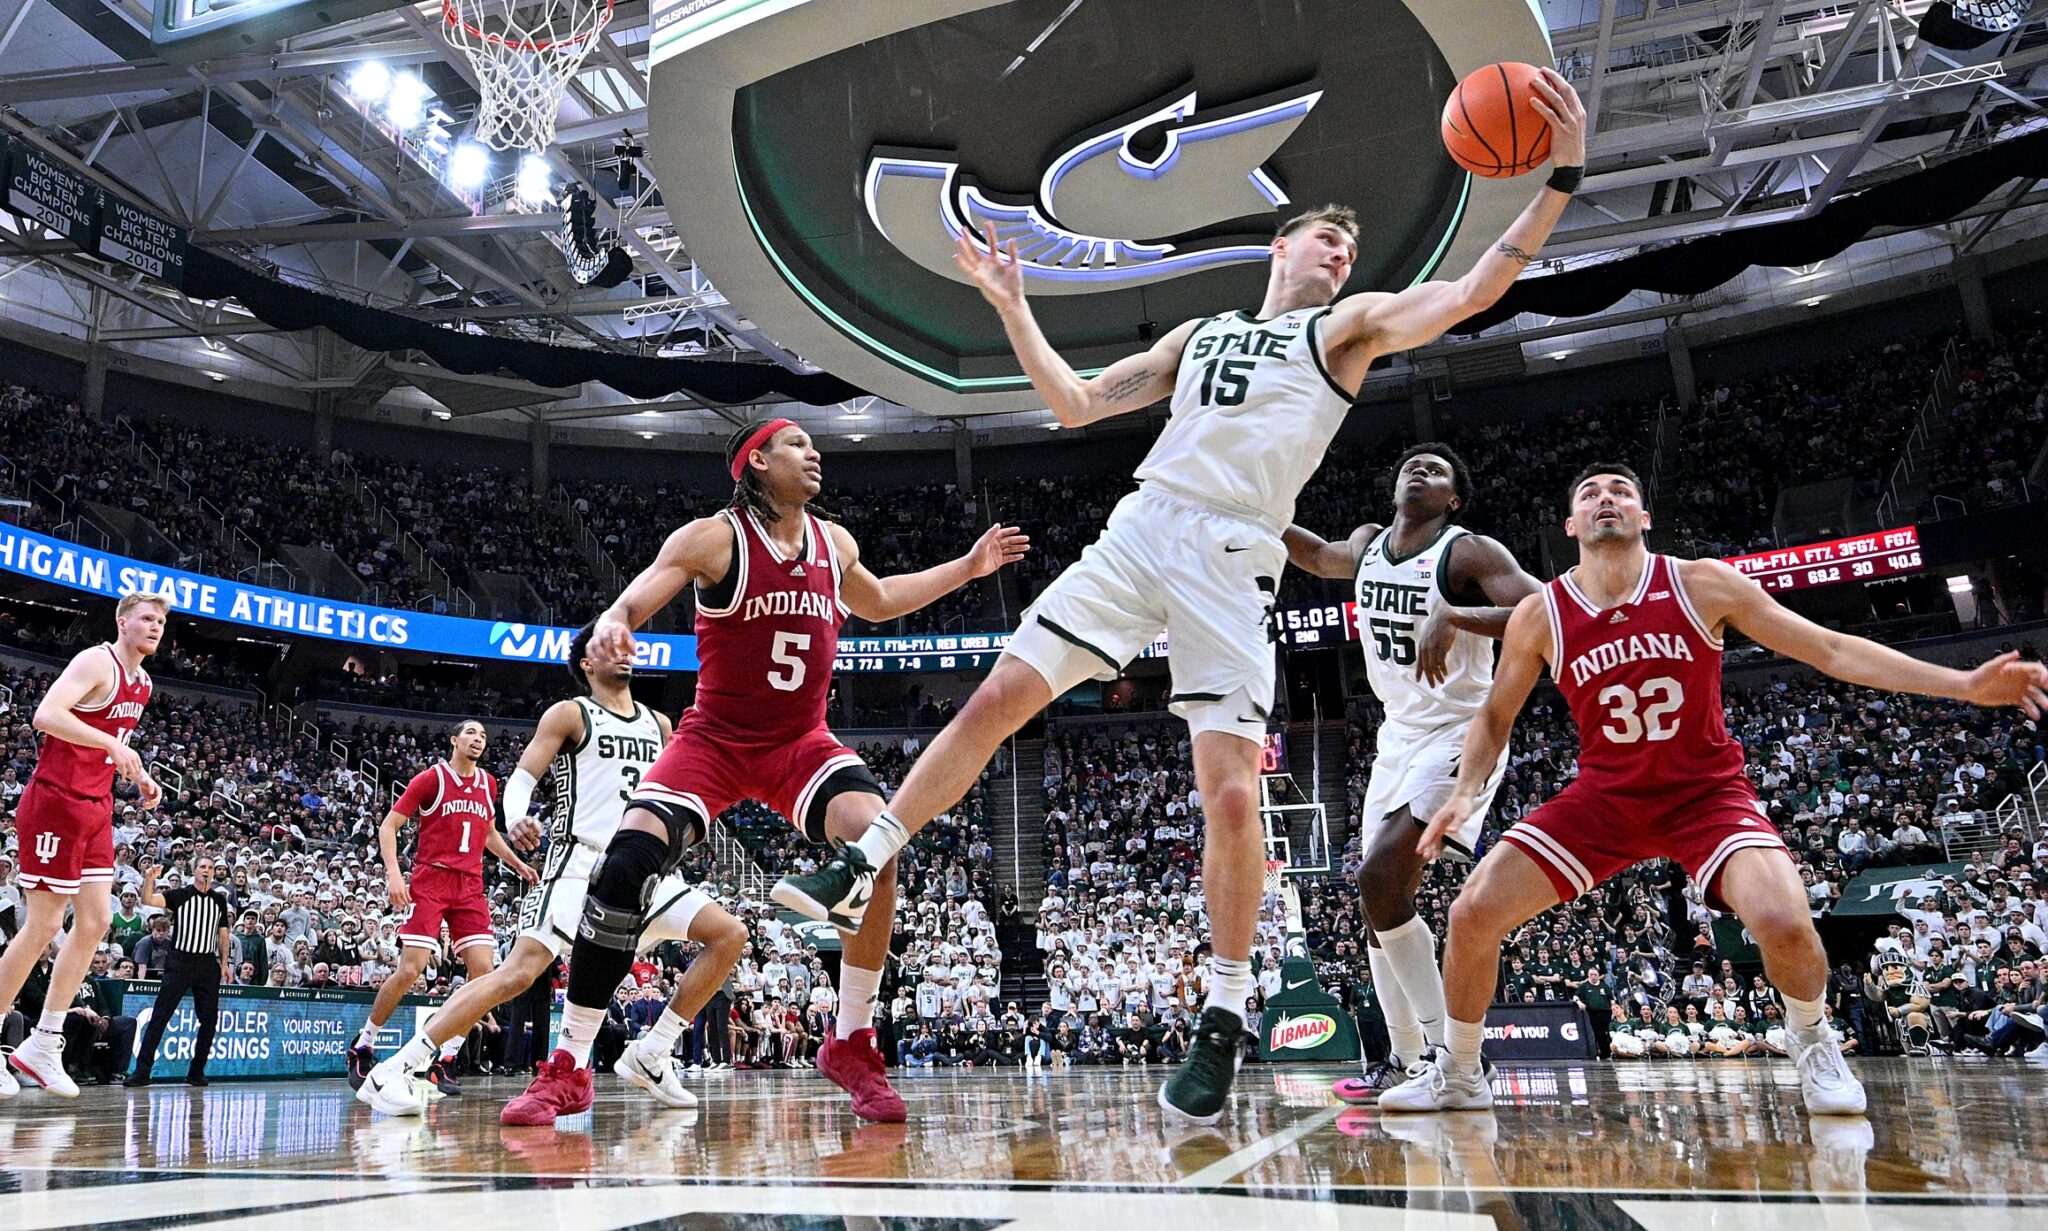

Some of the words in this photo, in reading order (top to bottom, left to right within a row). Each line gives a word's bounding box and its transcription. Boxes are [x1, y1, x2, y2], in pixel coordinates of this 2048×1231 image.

[26, 153, 85, 197] WOMEN'S
[30, 170, 52, 190] BIG
[54, 184, 78, 206] TEN
[14, 176, 90, 226] CHAMPIONS
[36, 206, 65, 231] 2011
[115, 203, 177, 239] WOMEN'S
[120, 218, 143, 237] BIG
[145, 230, 170, 249] TEN
[104, 224, 183, 267] CHAMPIONS
[125, 250, 159, 274] 2014
[1192, 329, 1297, 361] STATE
[1200, 358, 1257, 407] 15
[1804, 547, 1835, 563] FT%
[1838, 538, 1879, 557] 3FG%
[1883, 530, 1917, 549] FG%
[1807, 567, 1841, 584] 69.2
[1851, 561, 1874, 577] 30
[1887, 552, 1923, 570] 40.6
[117, 566, 219, 614] STATE
[229, 590, 409, 645] ATHLETICS
[742, 590, 834, 626] INDIANA
[1360, 580, 1431, 617] STATE
[1274, 606, 1340, 631] 15:02
[859, 640, 881, 653] FT%
[884, 638, 934, 652] FTM-FTA
[936, 637, 958, 651] REB
[960, 636, 990, 649] OREB
[1294, 629, 1320, 644] 2ND
[1369, 617, 1417, 666] 55
[766, 630, 812, 692] 5
[972, 654, 981, 667] 7
[1569, 632, 1695, 688] INDIANA
[105, 701, 145, 721] INDIAN
[1598, 676, 1685, 744] 32
[598, 735, 659, 763] STATE
[619, 766, 641, 801] 3
[441, 799, 488, 822] INDIANA
[458, 821, 471, 853] 1
[218, 988, 242, 996] CRISURE
[282, 1018, 311, 1034] YOUR
[313, 1020, 345, 1035] STYLE.
[1271, 1019, 1329, 1050] LIBMAN
[1560, 1022, 1580, 1041] G
[281, 1039, 311, 1055] YOUR
[312, 1040, 347, 1055] SPACE.
